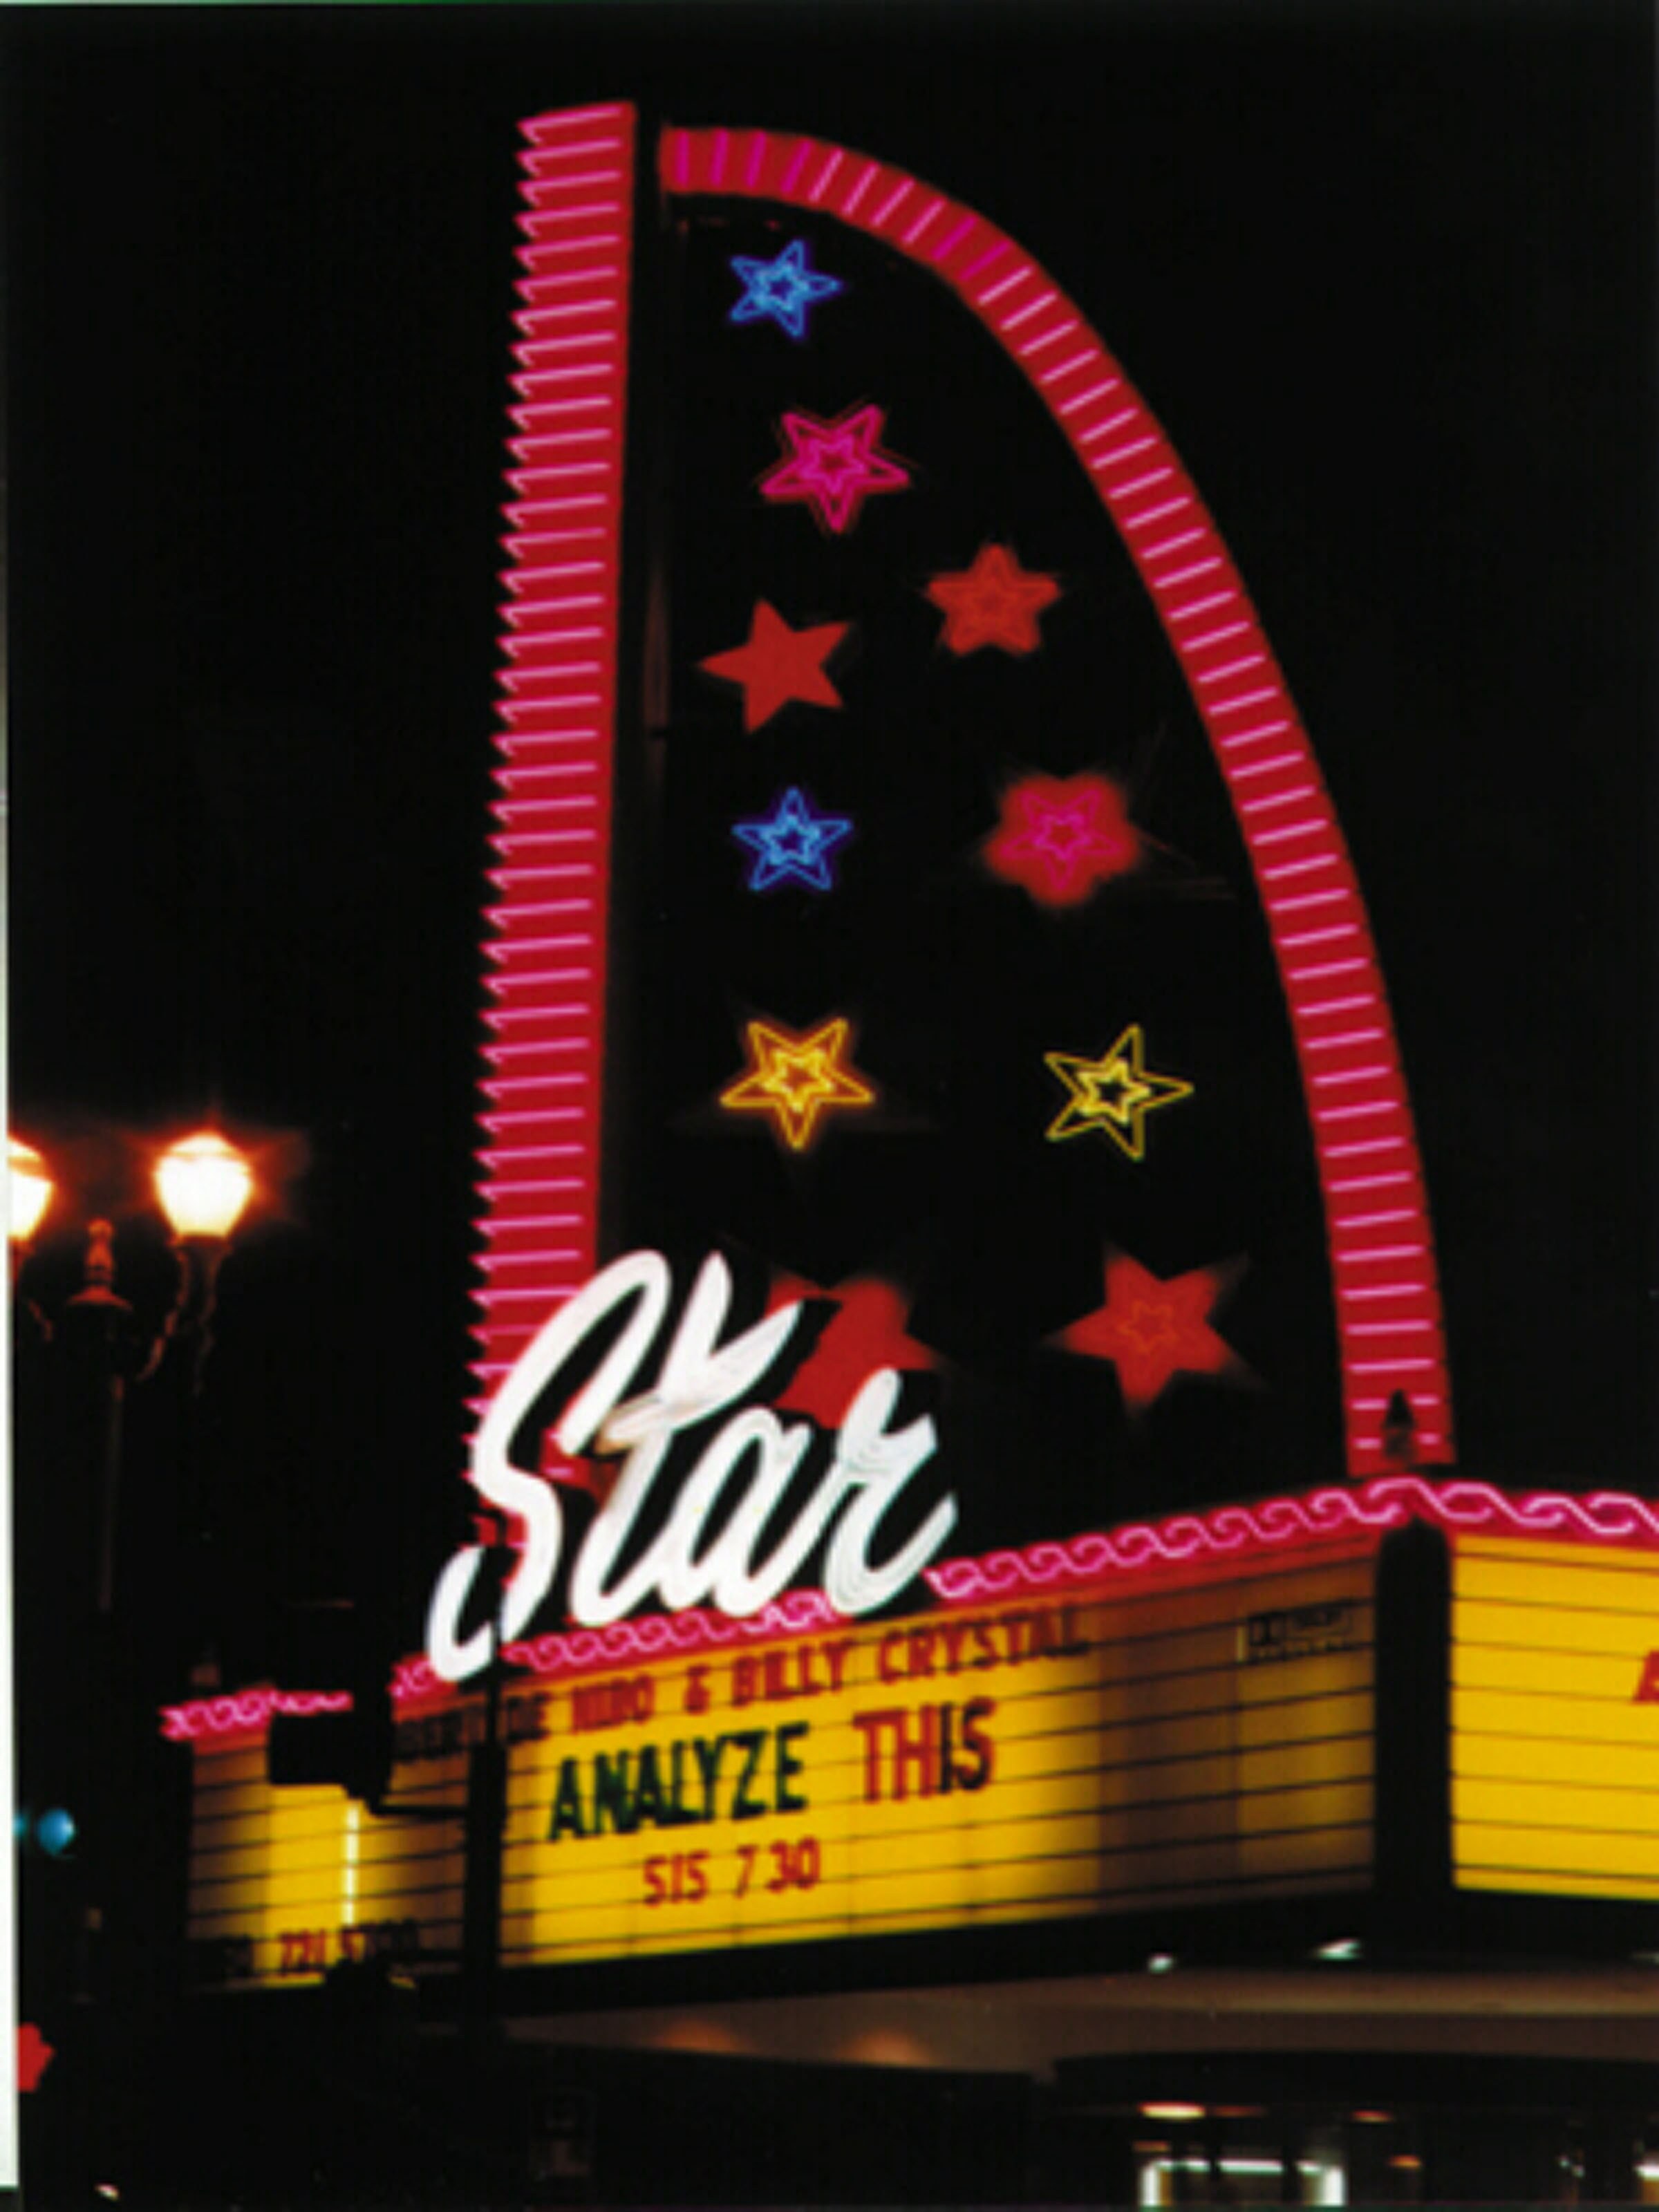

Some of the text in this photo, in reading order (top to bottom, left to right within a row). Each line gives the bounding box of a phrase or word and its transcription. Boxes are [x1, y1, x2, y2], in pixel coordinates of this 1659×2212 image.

[427, 1250, 957, 1681] Star
[684, 1665, 711, 1714] &
[731, 1638, 854, 1707] BILLY
[878, 1604, 1091, 1685] CRYSTAL
[549, 1721, 809, 1840] ANALYZE
[852, 1696, 997, 1804] THIS
